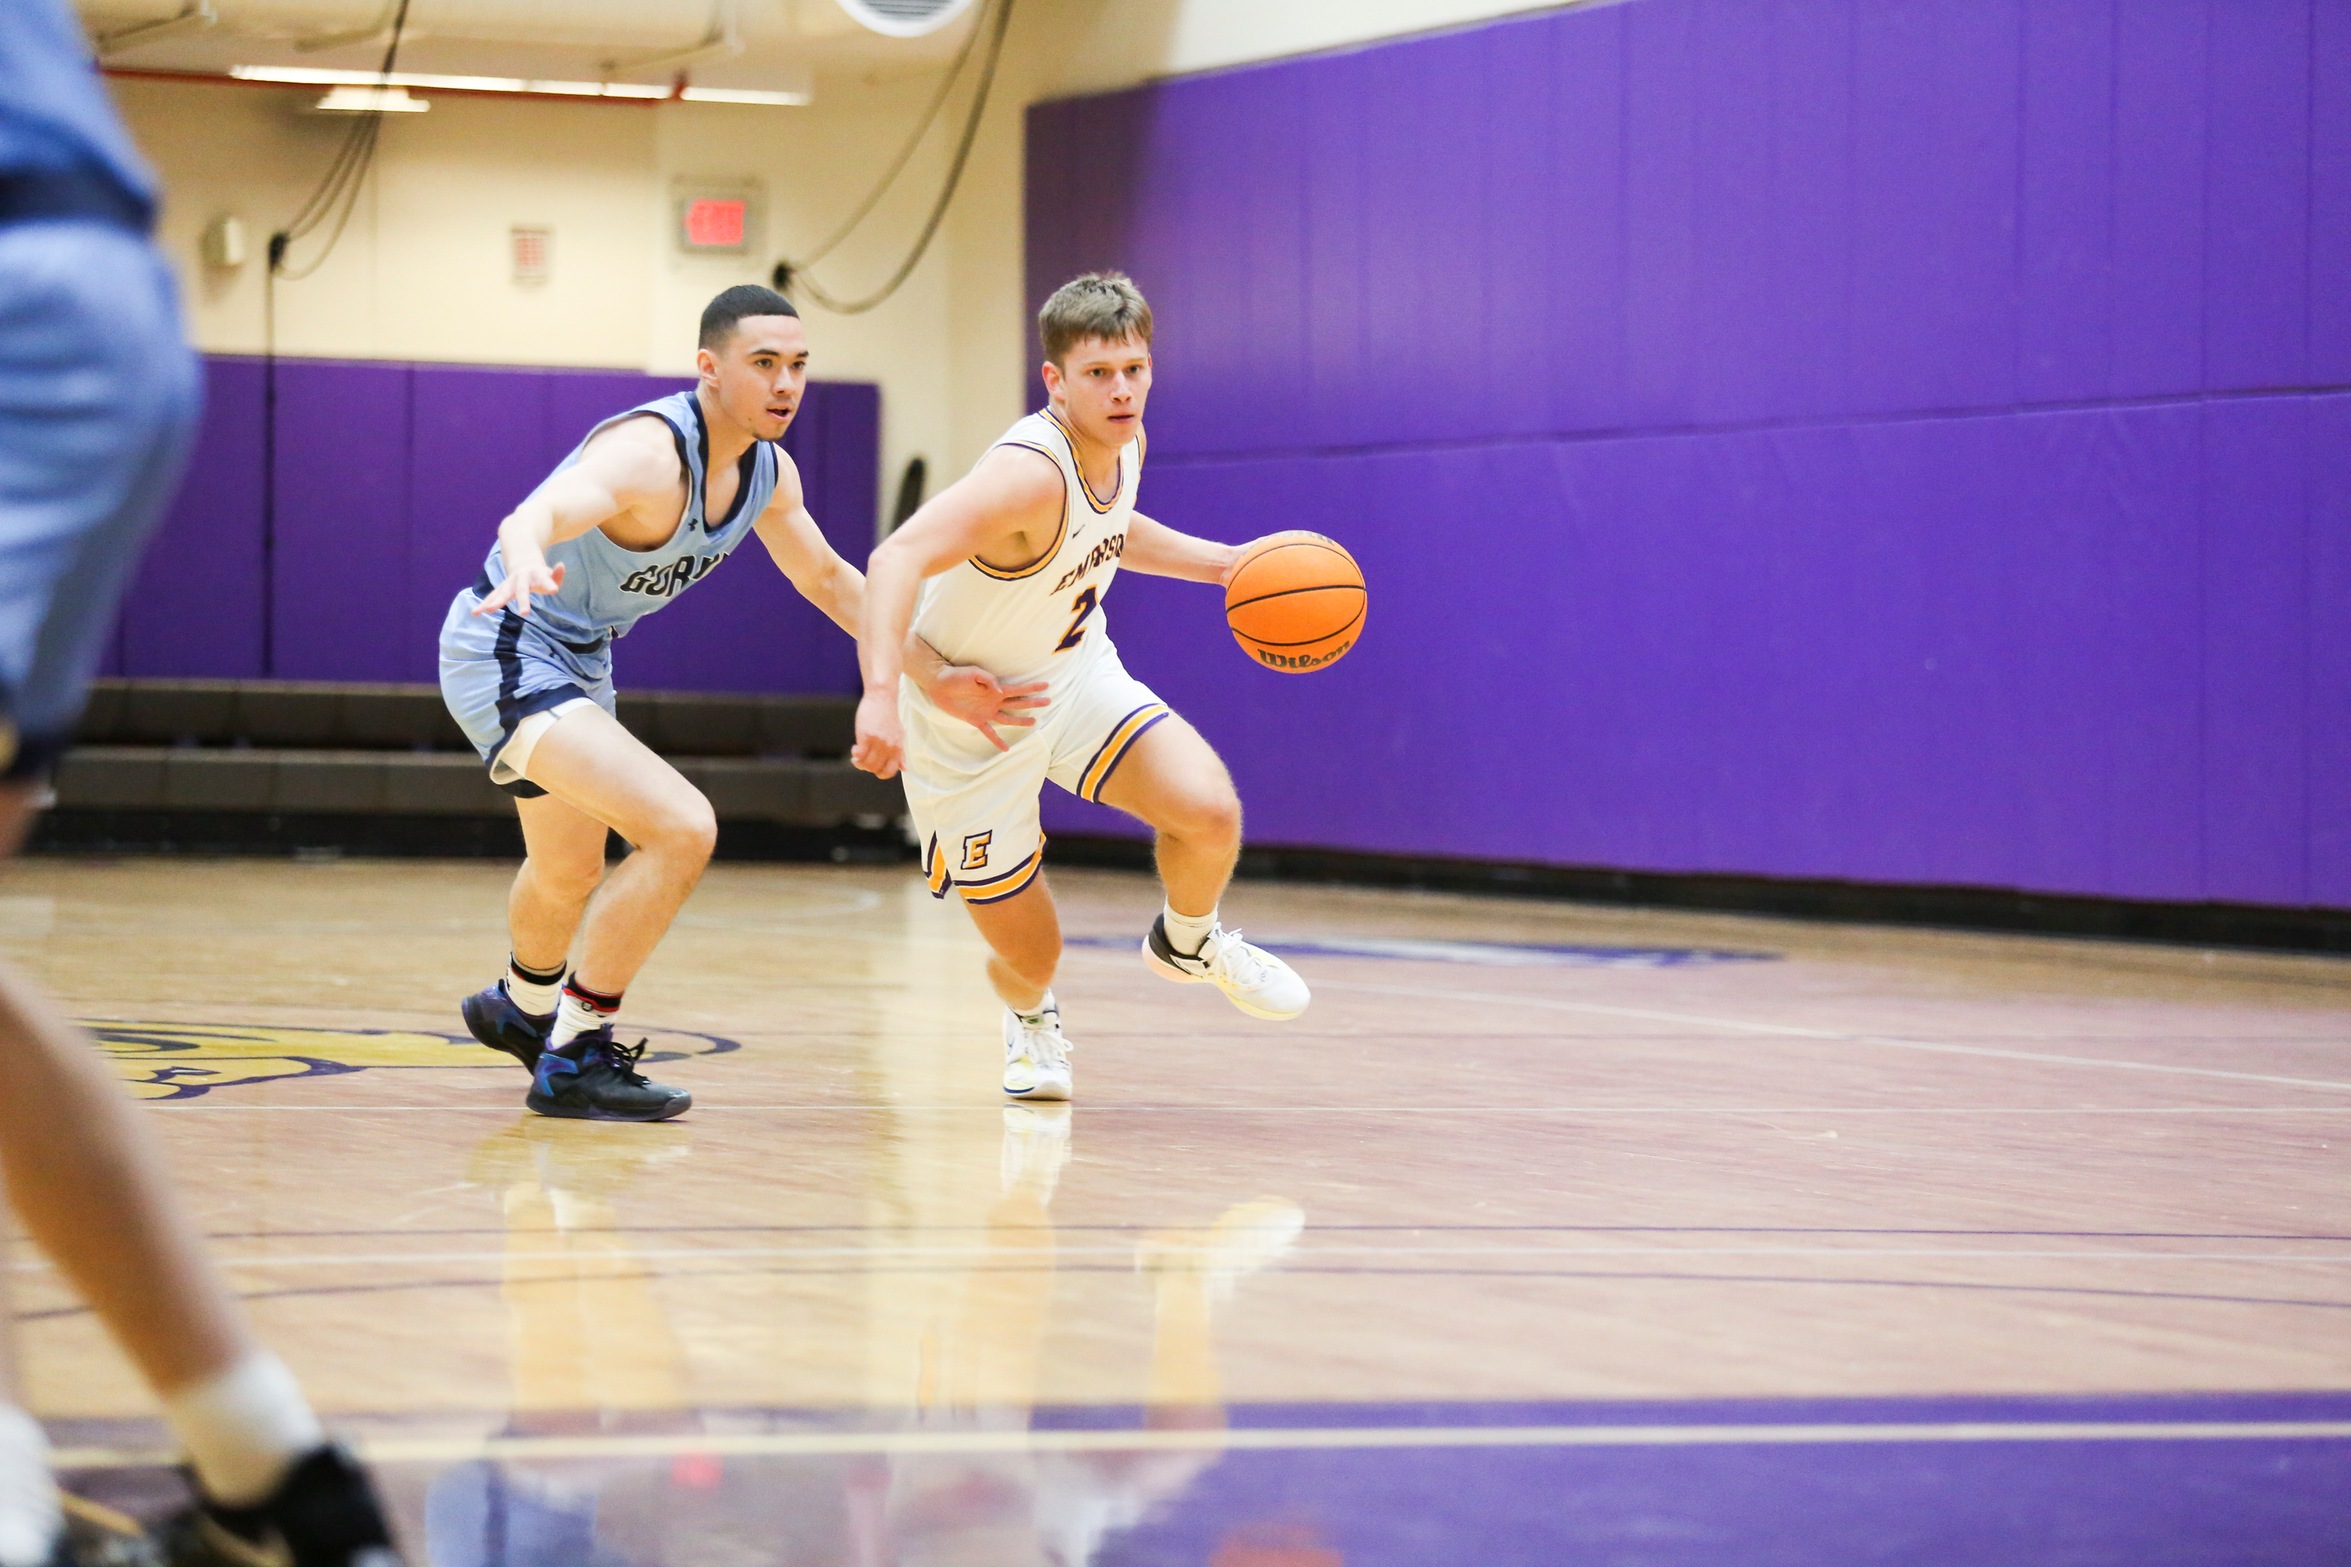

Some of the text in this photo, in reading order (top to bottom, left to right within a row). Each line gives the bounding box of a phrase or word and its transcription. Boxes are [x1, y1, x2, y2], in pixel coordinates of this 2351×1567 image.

[1052, 584, 1098, 654] 2
[1257, 641, 1350, 668] Wilson
[960, 829, 992, 870] E
